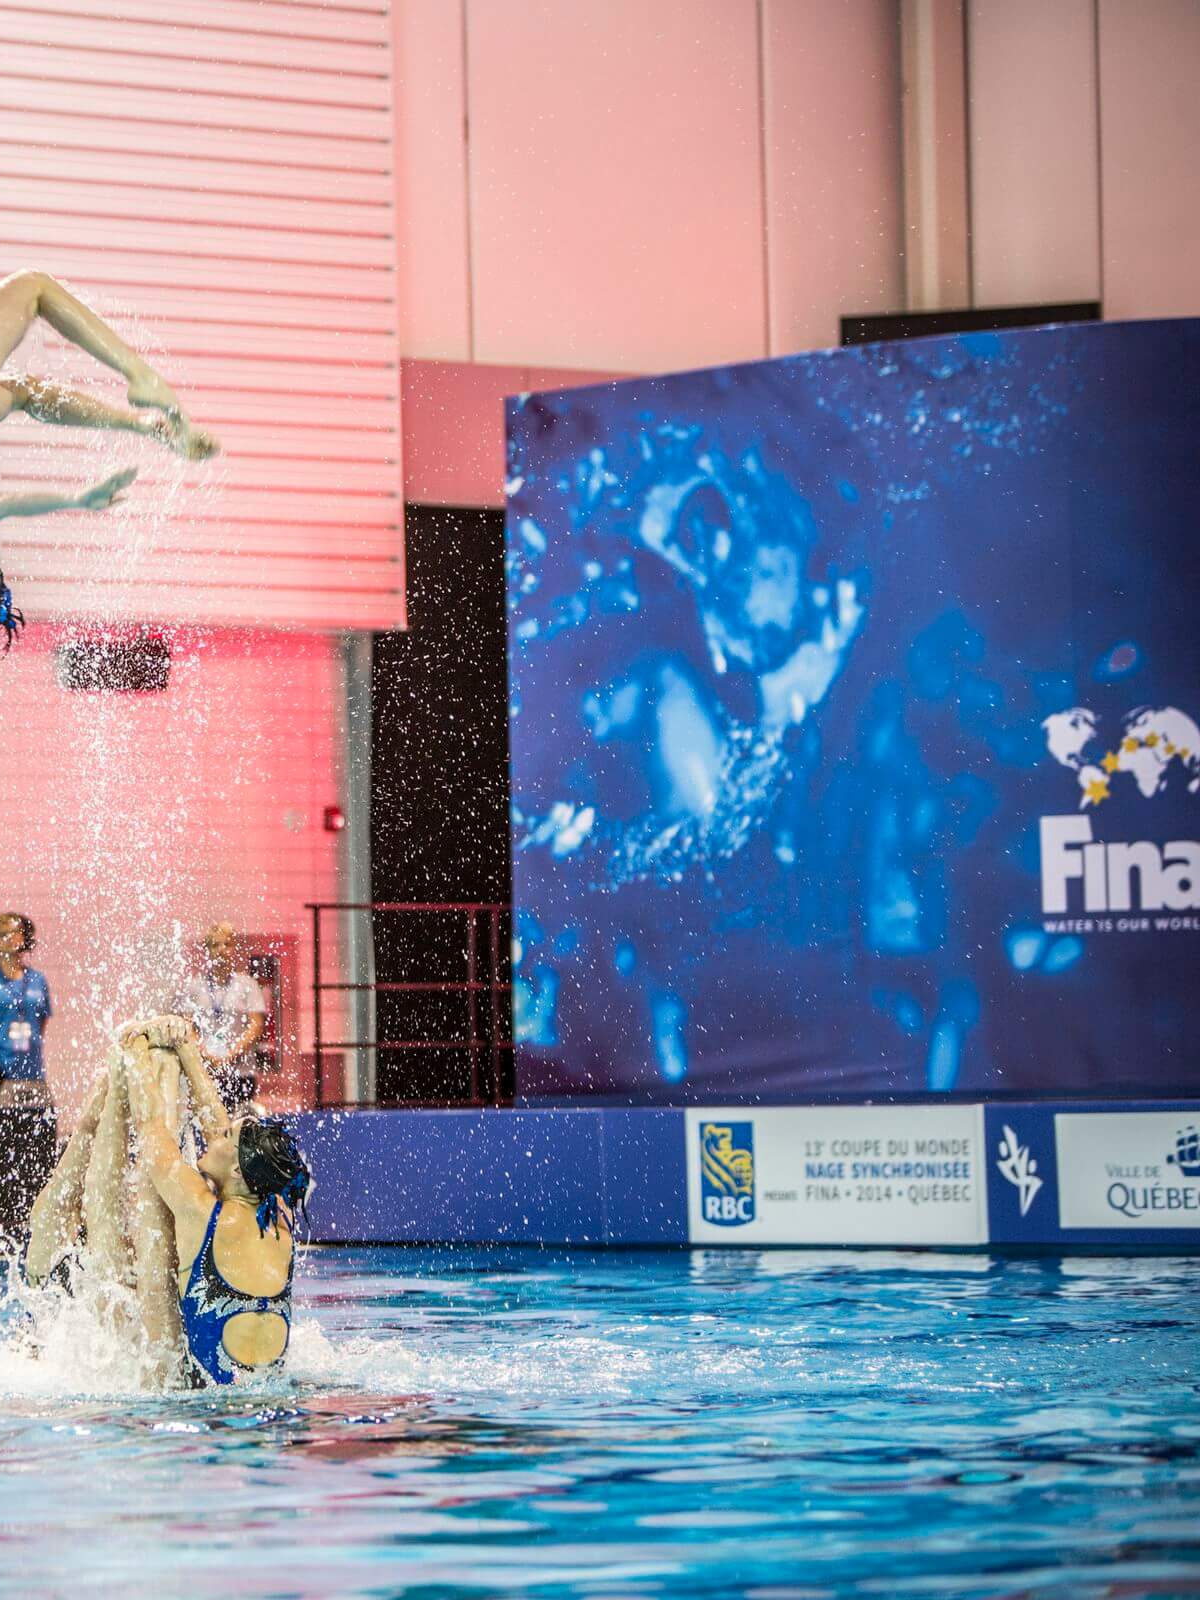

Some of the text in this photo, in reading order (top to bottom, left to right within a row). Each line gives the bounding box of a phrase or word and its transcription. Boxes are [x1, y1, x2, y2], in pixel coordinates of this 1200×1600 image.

[1043, 917, 1200, 934] WATER IS OUR WORL
[831, 1139, 881, 1157] COUPE
[887, 1140, 909, 1156] DU
[914, 1139, 971, 1156] MONDE
[805, 1158, 971, 1179] NAGE SYNCHRONISÉE
[805, 1181, 972, 1205] FINA 2014 QUÉBEC
[1106, 1181, 1200, 1219] QUÉBE
[705, 1195, 753, 1220] RBC
